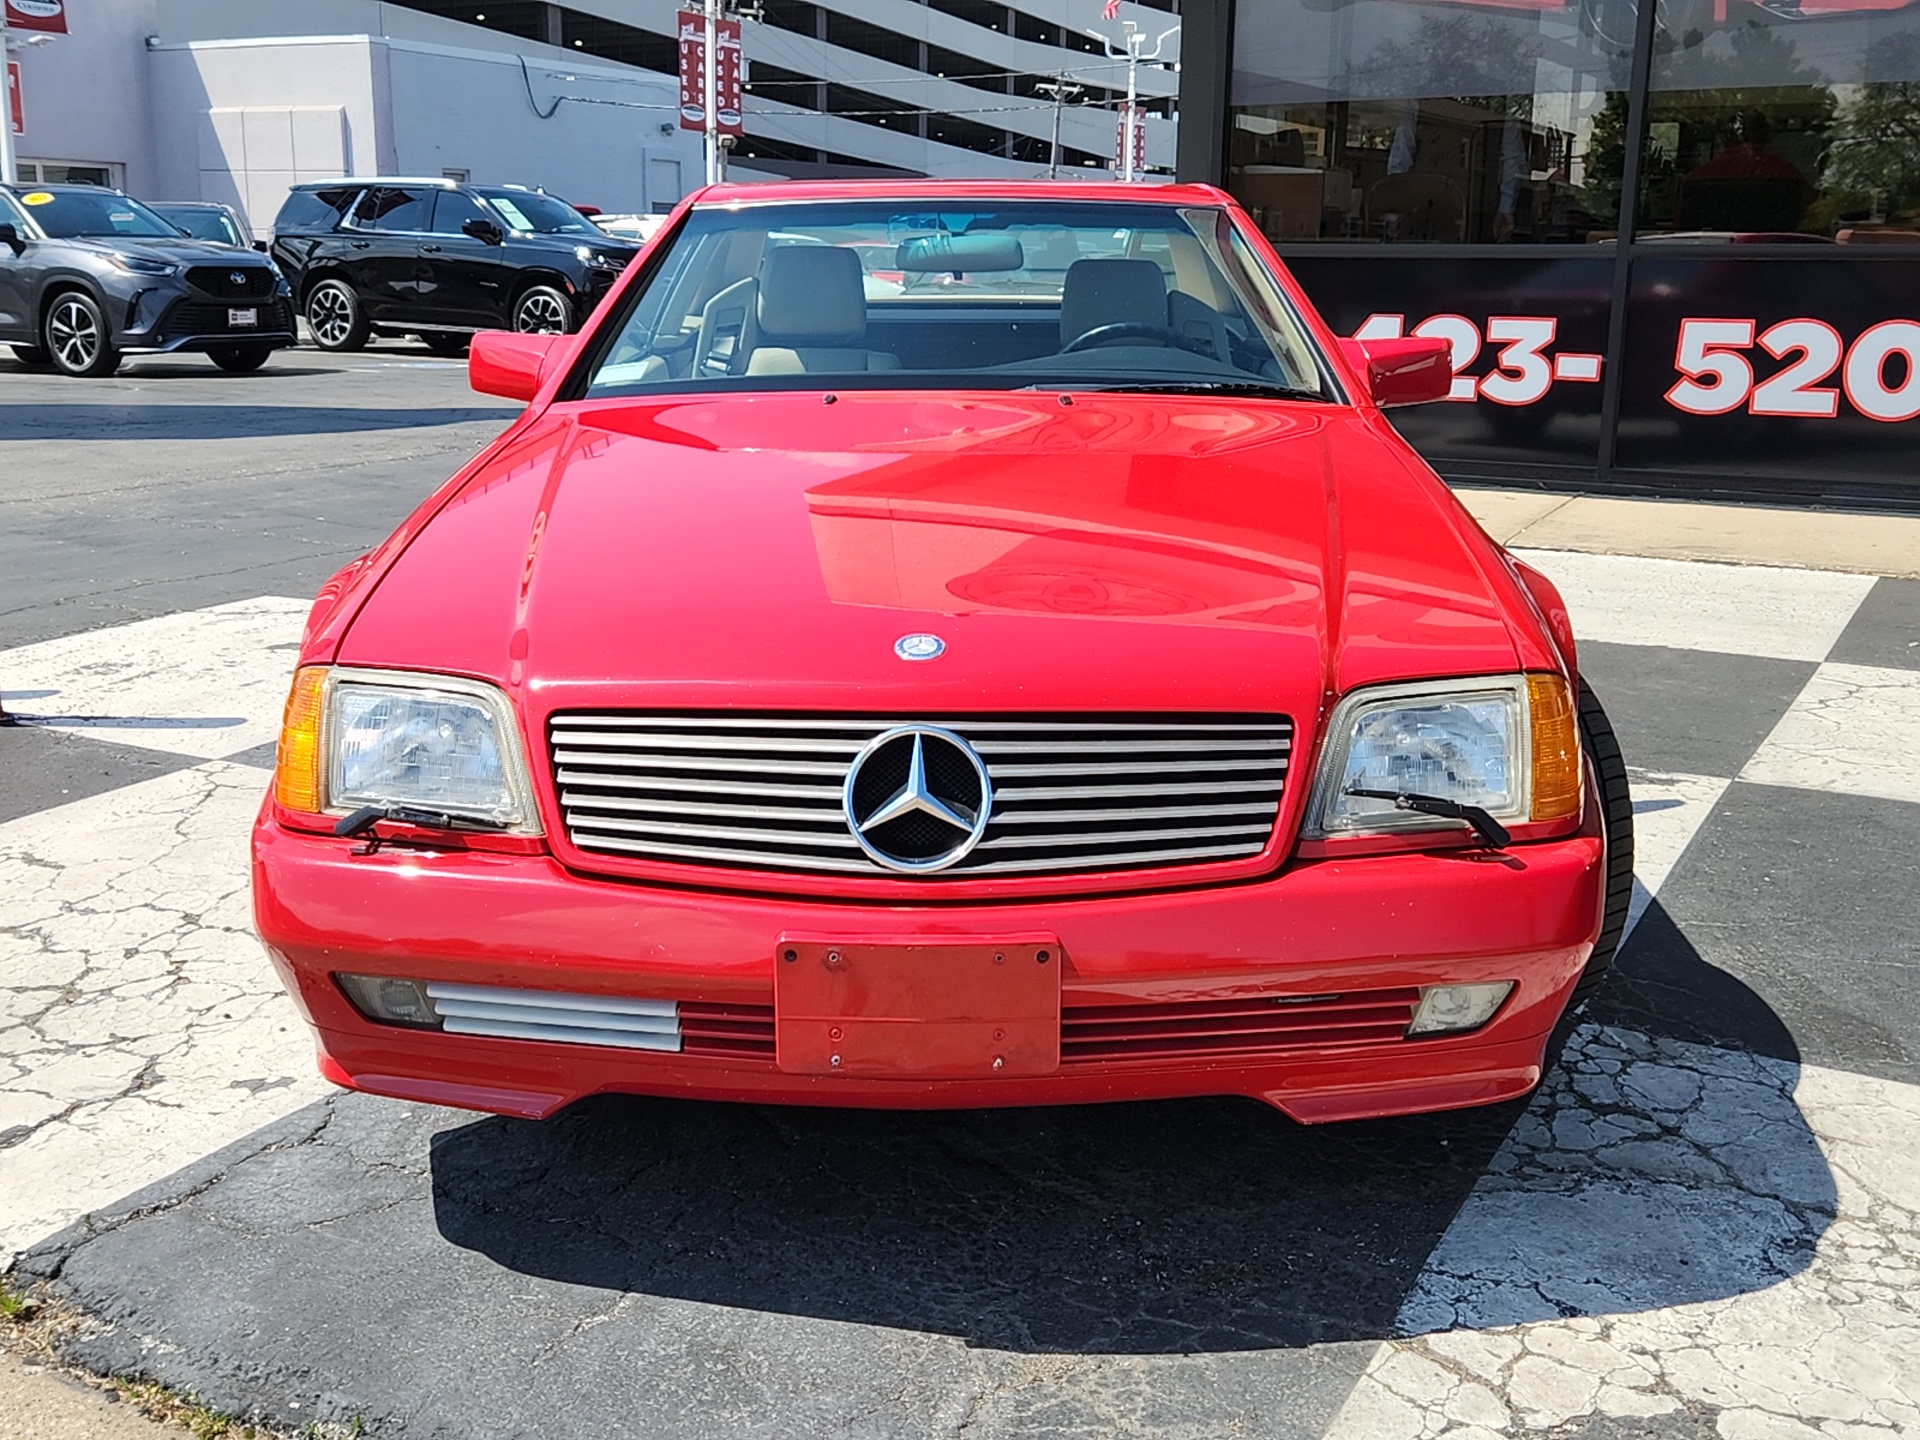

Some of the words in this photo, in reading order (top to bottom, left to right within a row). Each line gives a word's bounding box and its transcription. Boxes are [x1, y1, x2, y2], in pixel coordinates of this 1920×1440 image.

[680, 42, 690, 102] USED
[696, 46, 704, 105] CARS
[717, 49, 726, 108] USED
[732, 52, 740, 109] CARS
